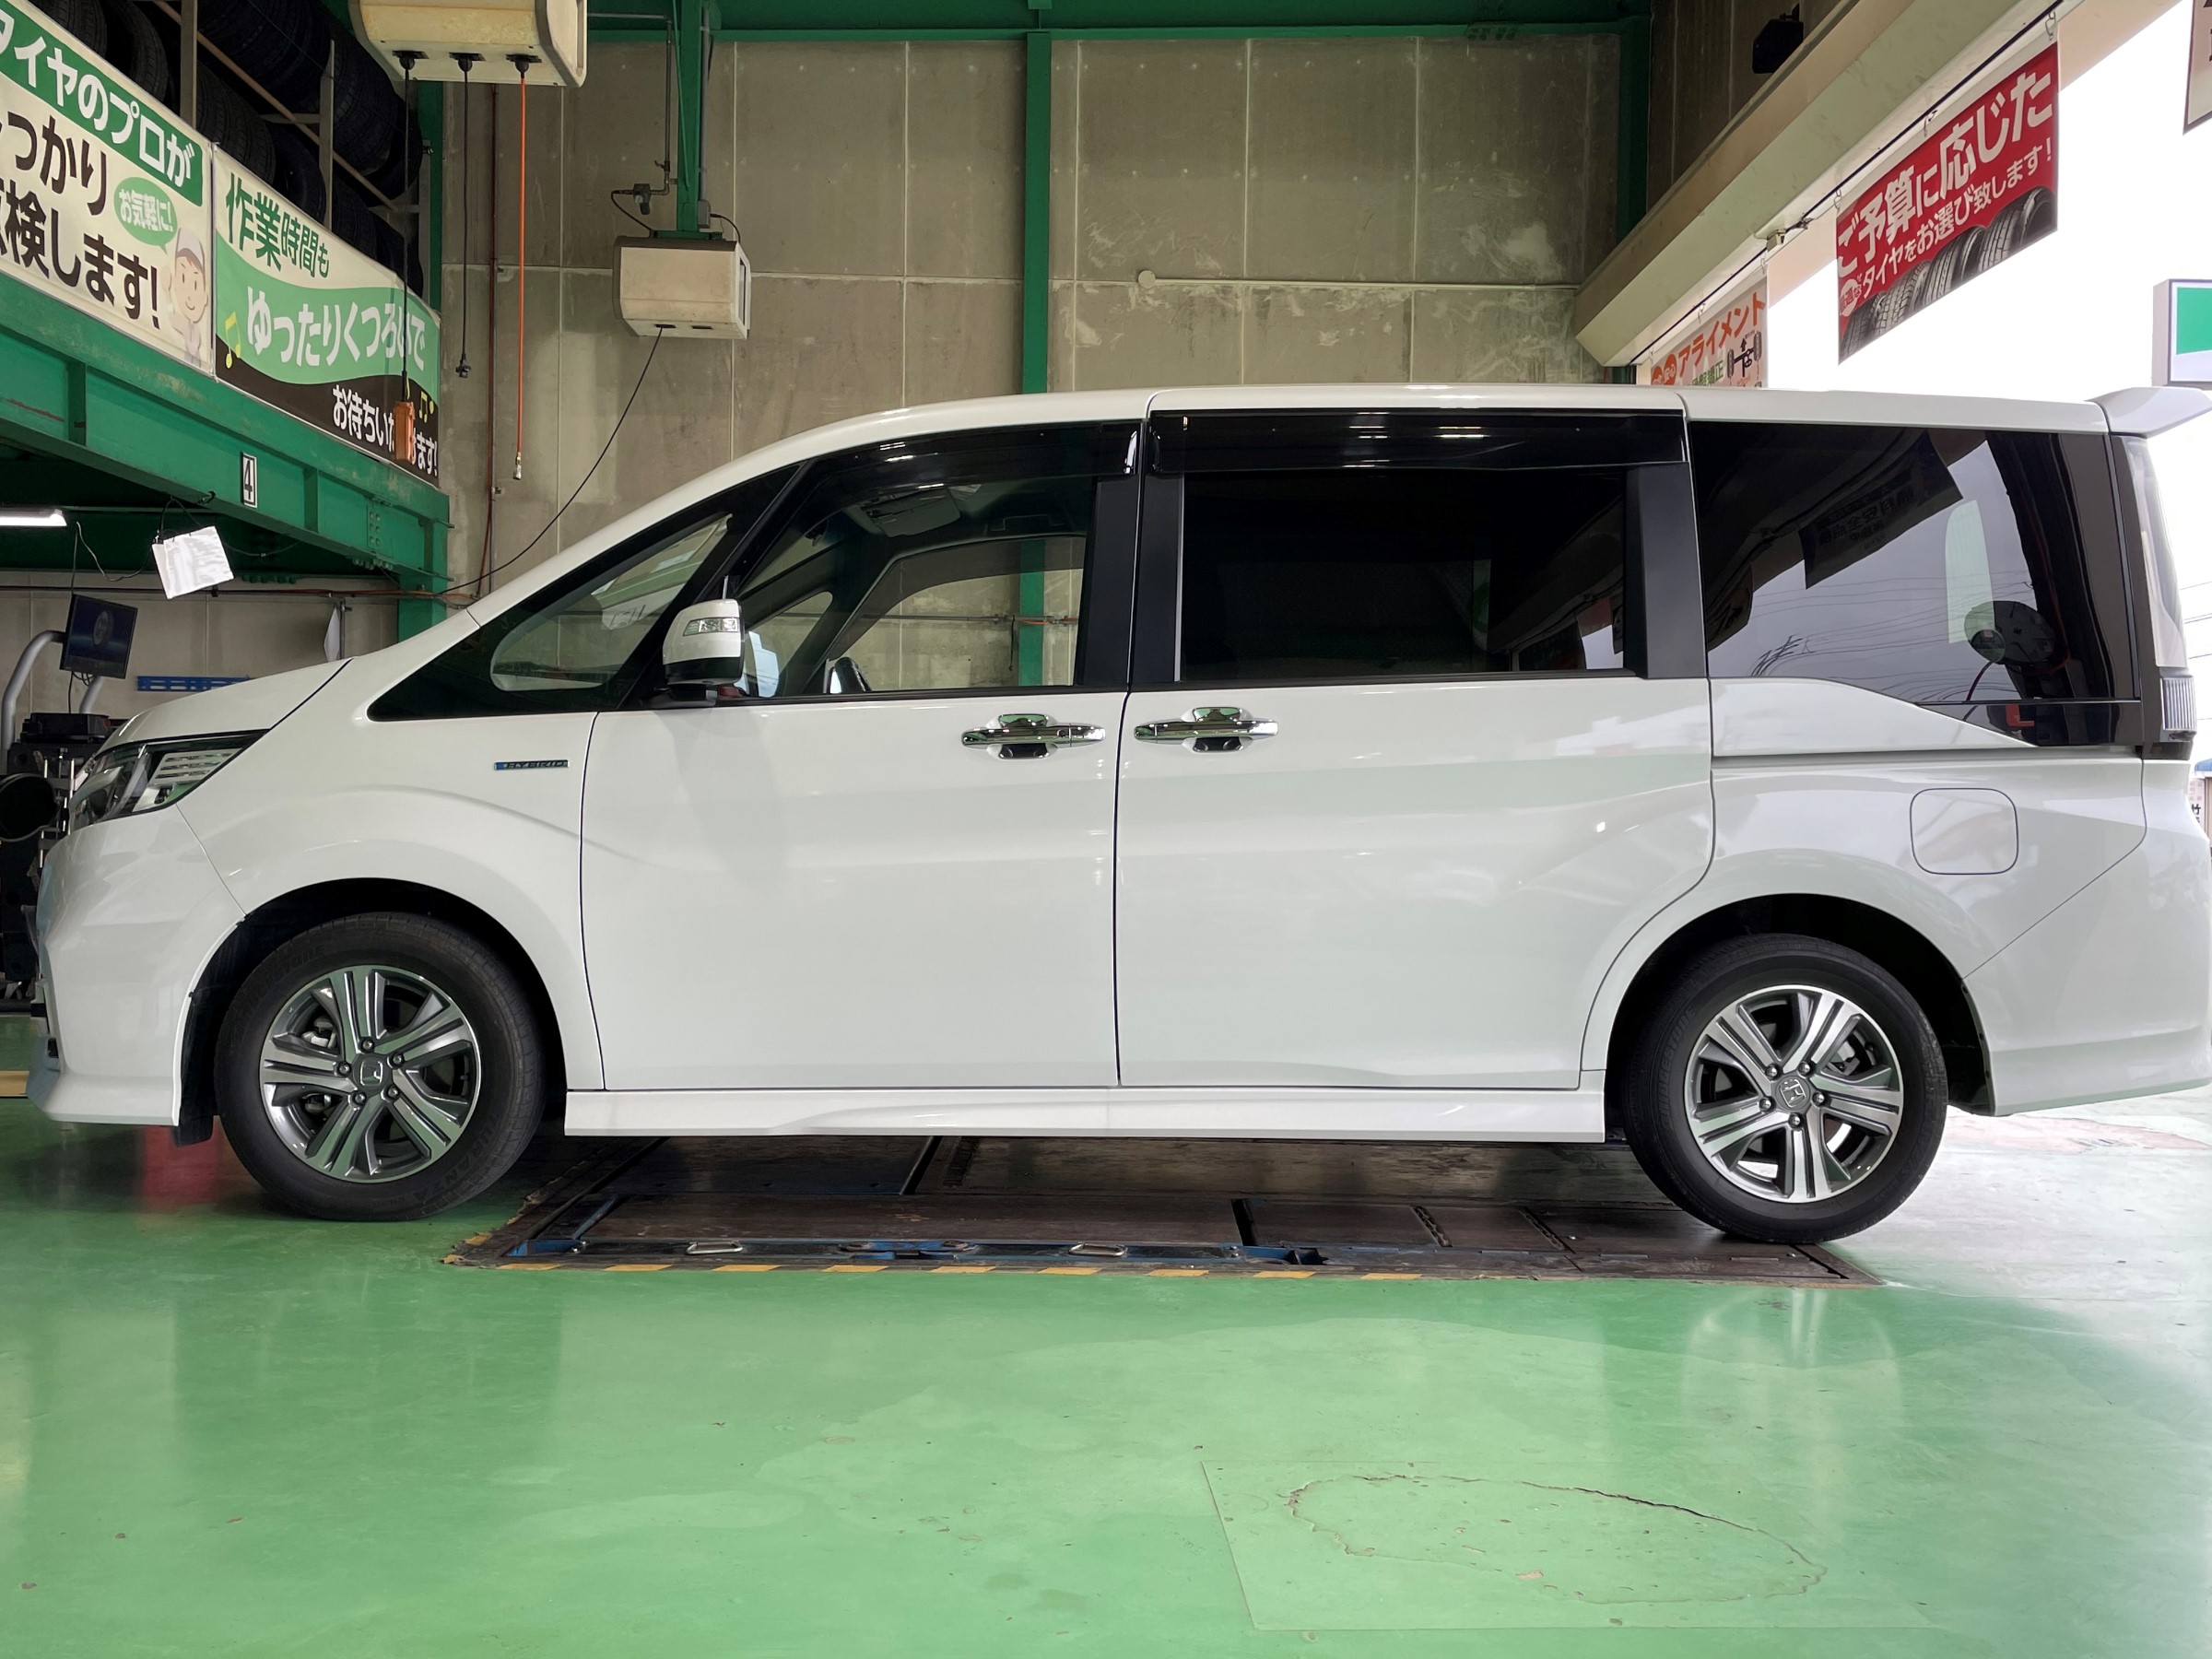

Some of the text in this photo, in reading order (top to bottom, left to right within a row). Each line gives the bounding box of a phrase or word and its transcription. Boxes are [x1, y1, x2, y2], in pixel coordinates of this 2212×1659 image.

[0, 112, 106, 216] っかり
[119, 188, 174, 232] お気軽に!
[1838, 72, 2053, 277] ご予算に応じた
[0, 178, 160, 330] 検します!
[226, 171, 329, 278] 作業時間も
[247, 286, 426, 371] ゆったりくつろいで
[1678, 291, 1766, 378] アライメント
[244, 460, 253, 500] 4
